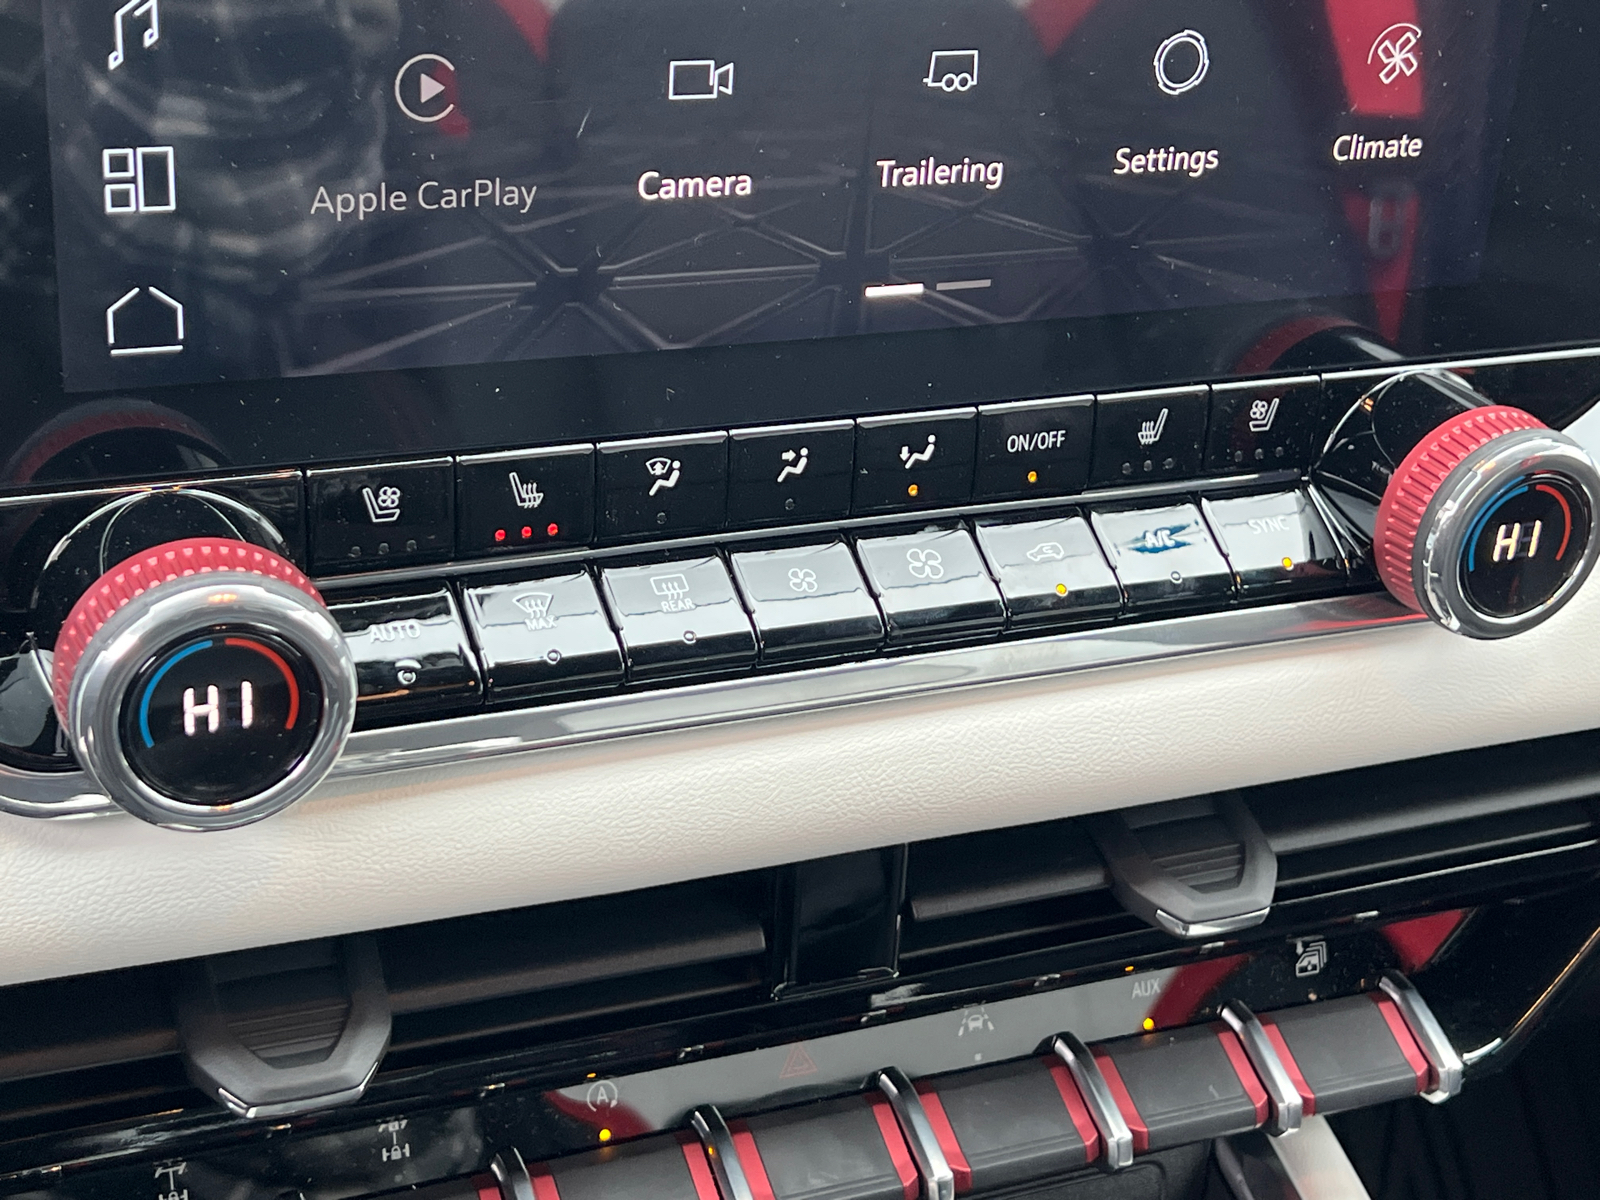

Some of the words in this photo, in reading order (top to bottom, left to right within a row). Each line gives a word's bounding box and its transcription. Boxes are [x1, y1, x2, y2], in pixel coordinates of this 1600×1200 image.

[1332, 133, 1423, 163] Climate
[876, 157, 1005, 191] Trailering
[1113, 146, 1220, 178] Settings
[636, 170, 754, 202] Camera
[310, 184, 409, 221] Apple
[416, 180, 538, 214] CarPlay
[1006, 429, 1067, 454] ON/OFF
[1144, 528, 1176, 549] A/C
[1248, 516, 1290, 535] SYNC
[1493, 519, 1542, 563] HI
[660, 597, 694, 613] REAR
[369, 620, 421, 645] AUTO
[524, 616, 557, 631] MAX
[181, 680, 254, 736] HI
[1131, 979, 1161, 999] AUX
